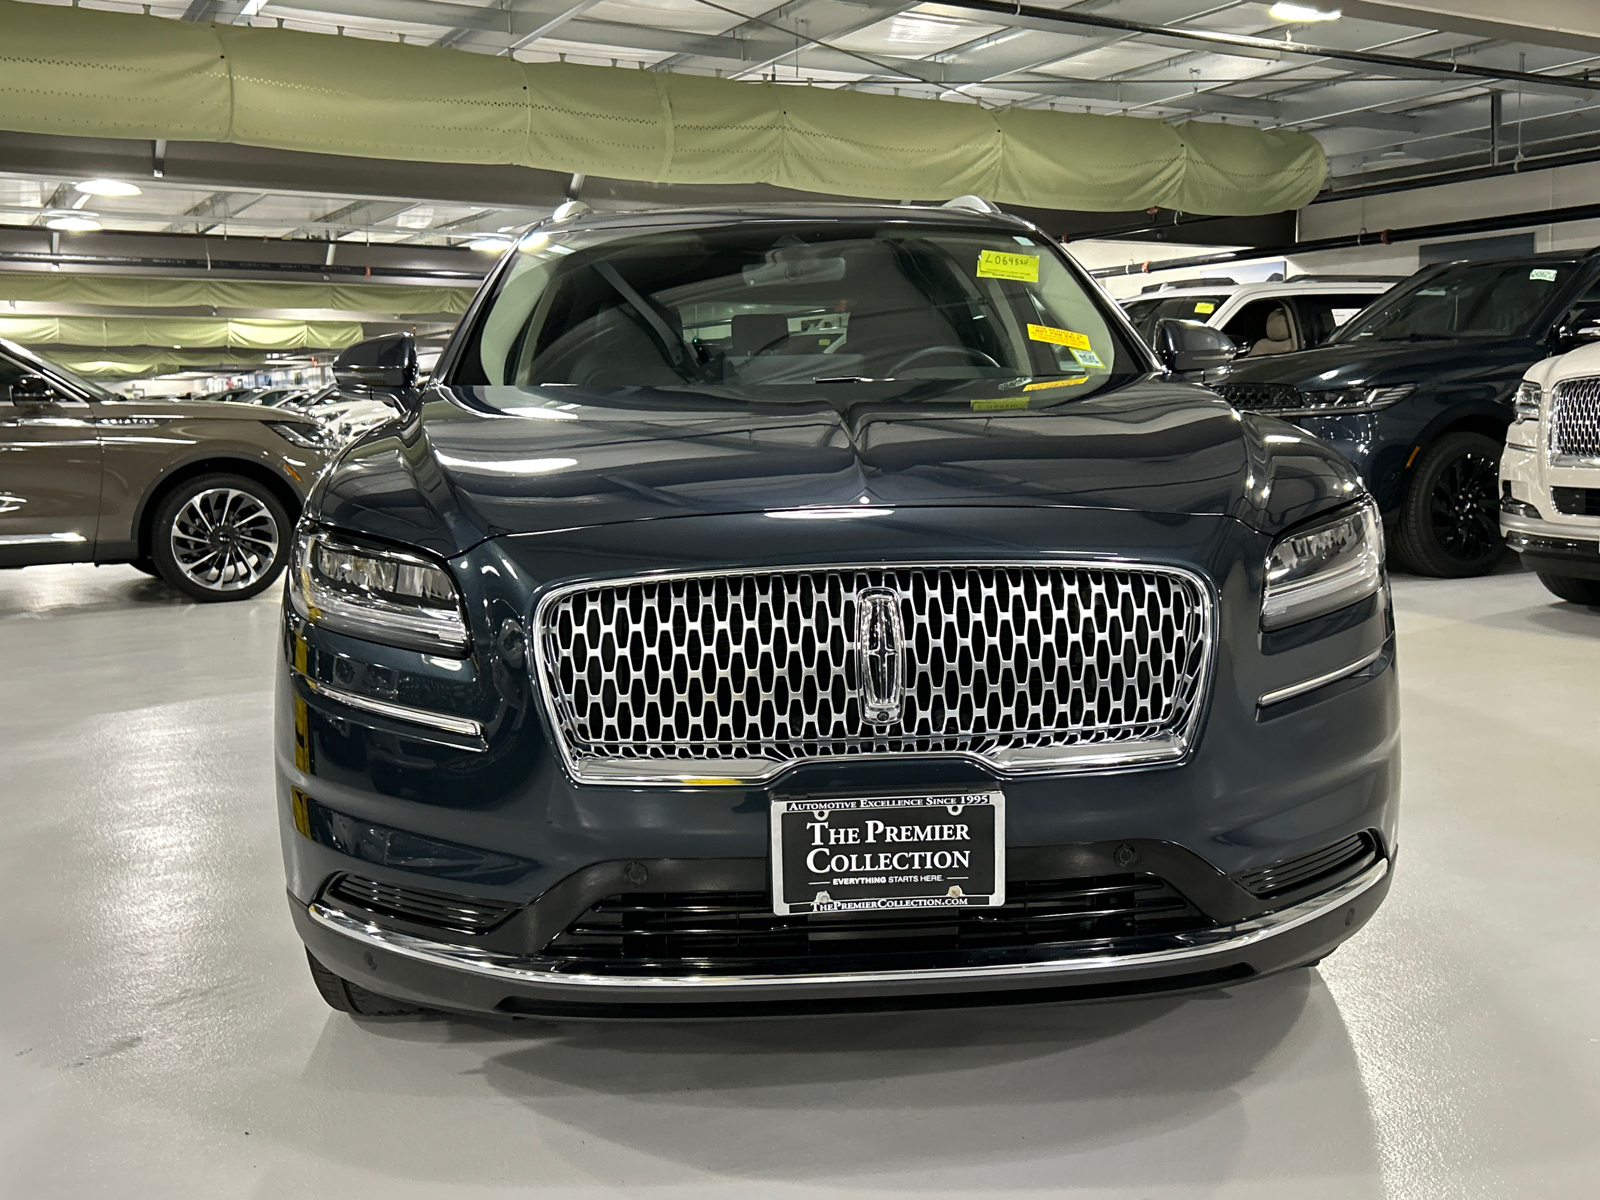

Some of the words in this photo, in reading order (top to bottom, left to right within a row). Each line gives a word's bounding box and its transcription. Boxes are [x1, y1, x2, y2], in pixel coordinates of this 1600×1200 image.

[788, 802, 857, 812] AUTOMOTIVE
[859, 798, 924, 808] EXCELLENCE
[925, 796, 957, 806] SINCE
[960, 795, 989, 804] 1995
[806, 821, 860, 846] THE
[865, 820, 971, 843] PREMIER
[806, 847, 971, 874] COLLECTION
[832, 876, 887, 886] EVERYTHING
[888, 875, 919, 884] STARTS
[810, 897, 969, 912] THEPREMIERCOLLECTION.COM
